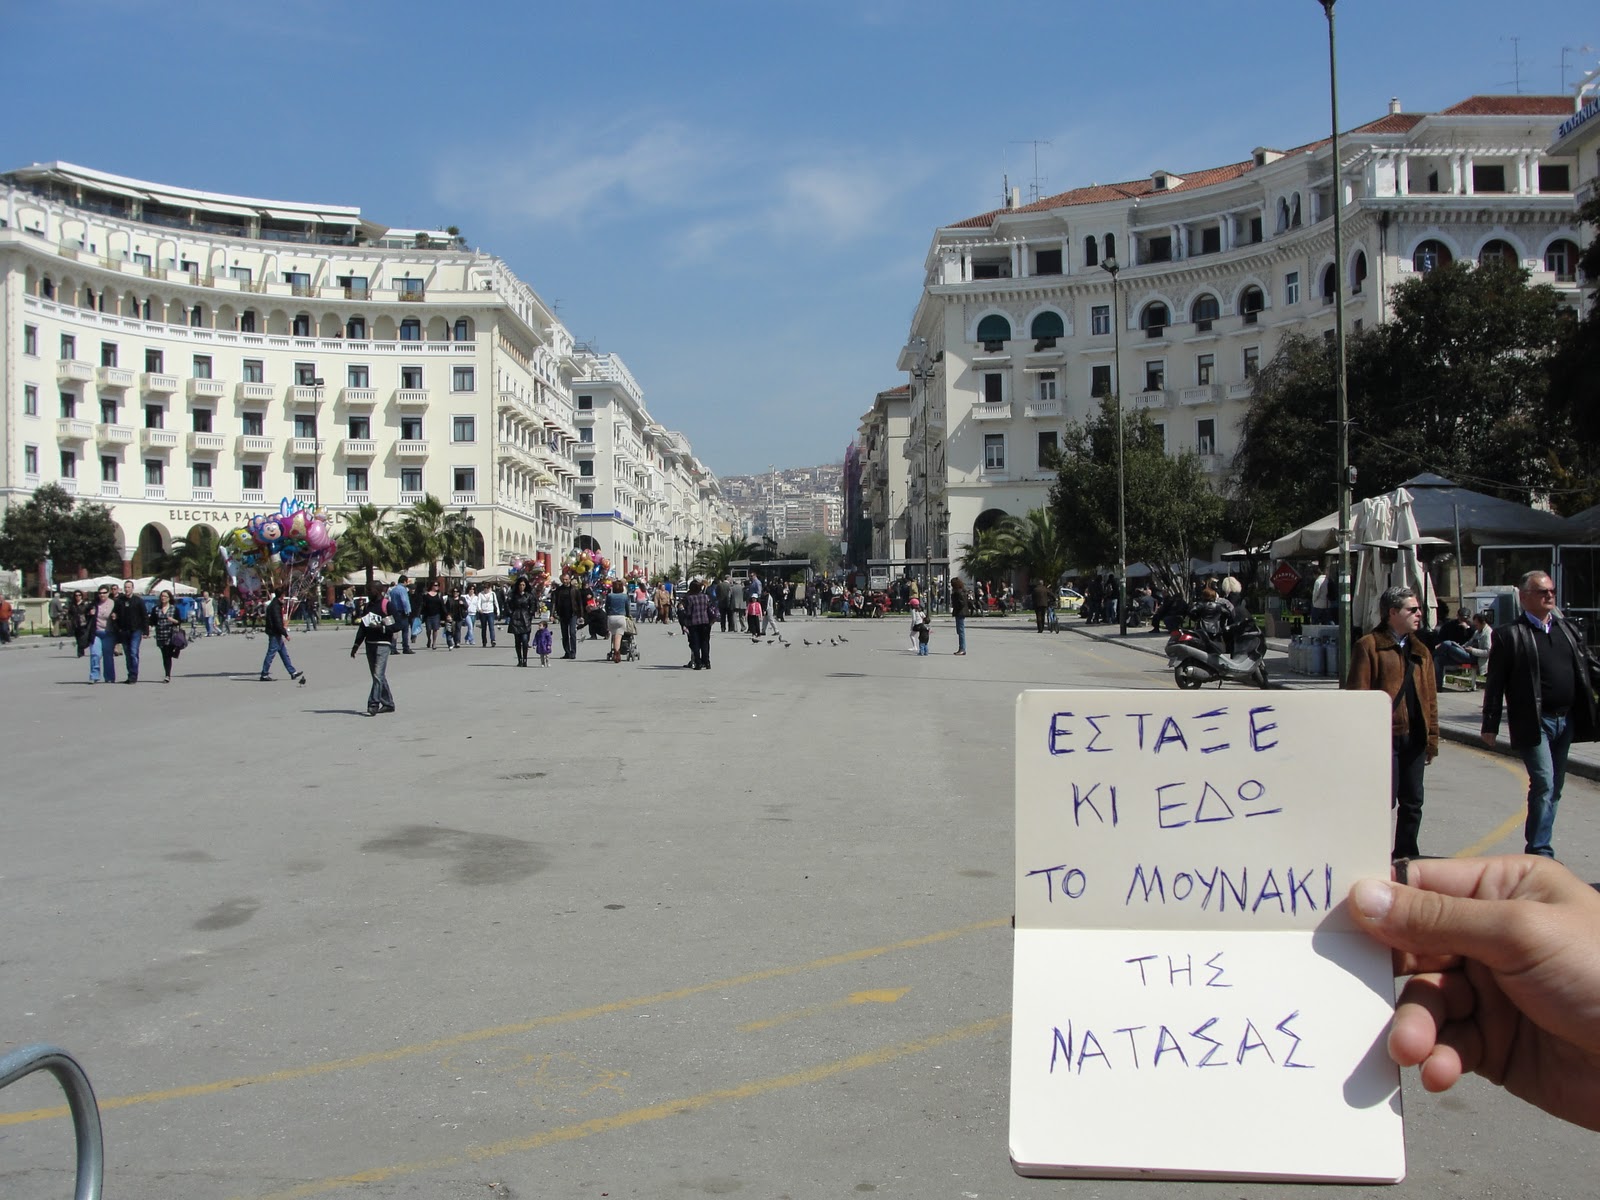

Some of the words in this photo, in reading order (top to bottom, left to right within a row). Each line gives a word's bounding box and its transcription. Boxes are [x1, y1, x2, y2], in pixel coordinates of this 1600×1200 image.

[169, 509, 229, 522] ELECTRA
[1048, 705, 1279, 756] ΕΣΤΑΞΕ
[1071, 782, 1118, 827] ΚΙ
[1025, 864, 1087, 903] ΤΟ
[1126, 863, 1333, 916] ΜΟΥΝΑΚΙ
[1125, 952, 1233, 987] ΤΗΣ
[1050, 1010, 1315, 1074] ΝΑΤΑΣΑΣ
